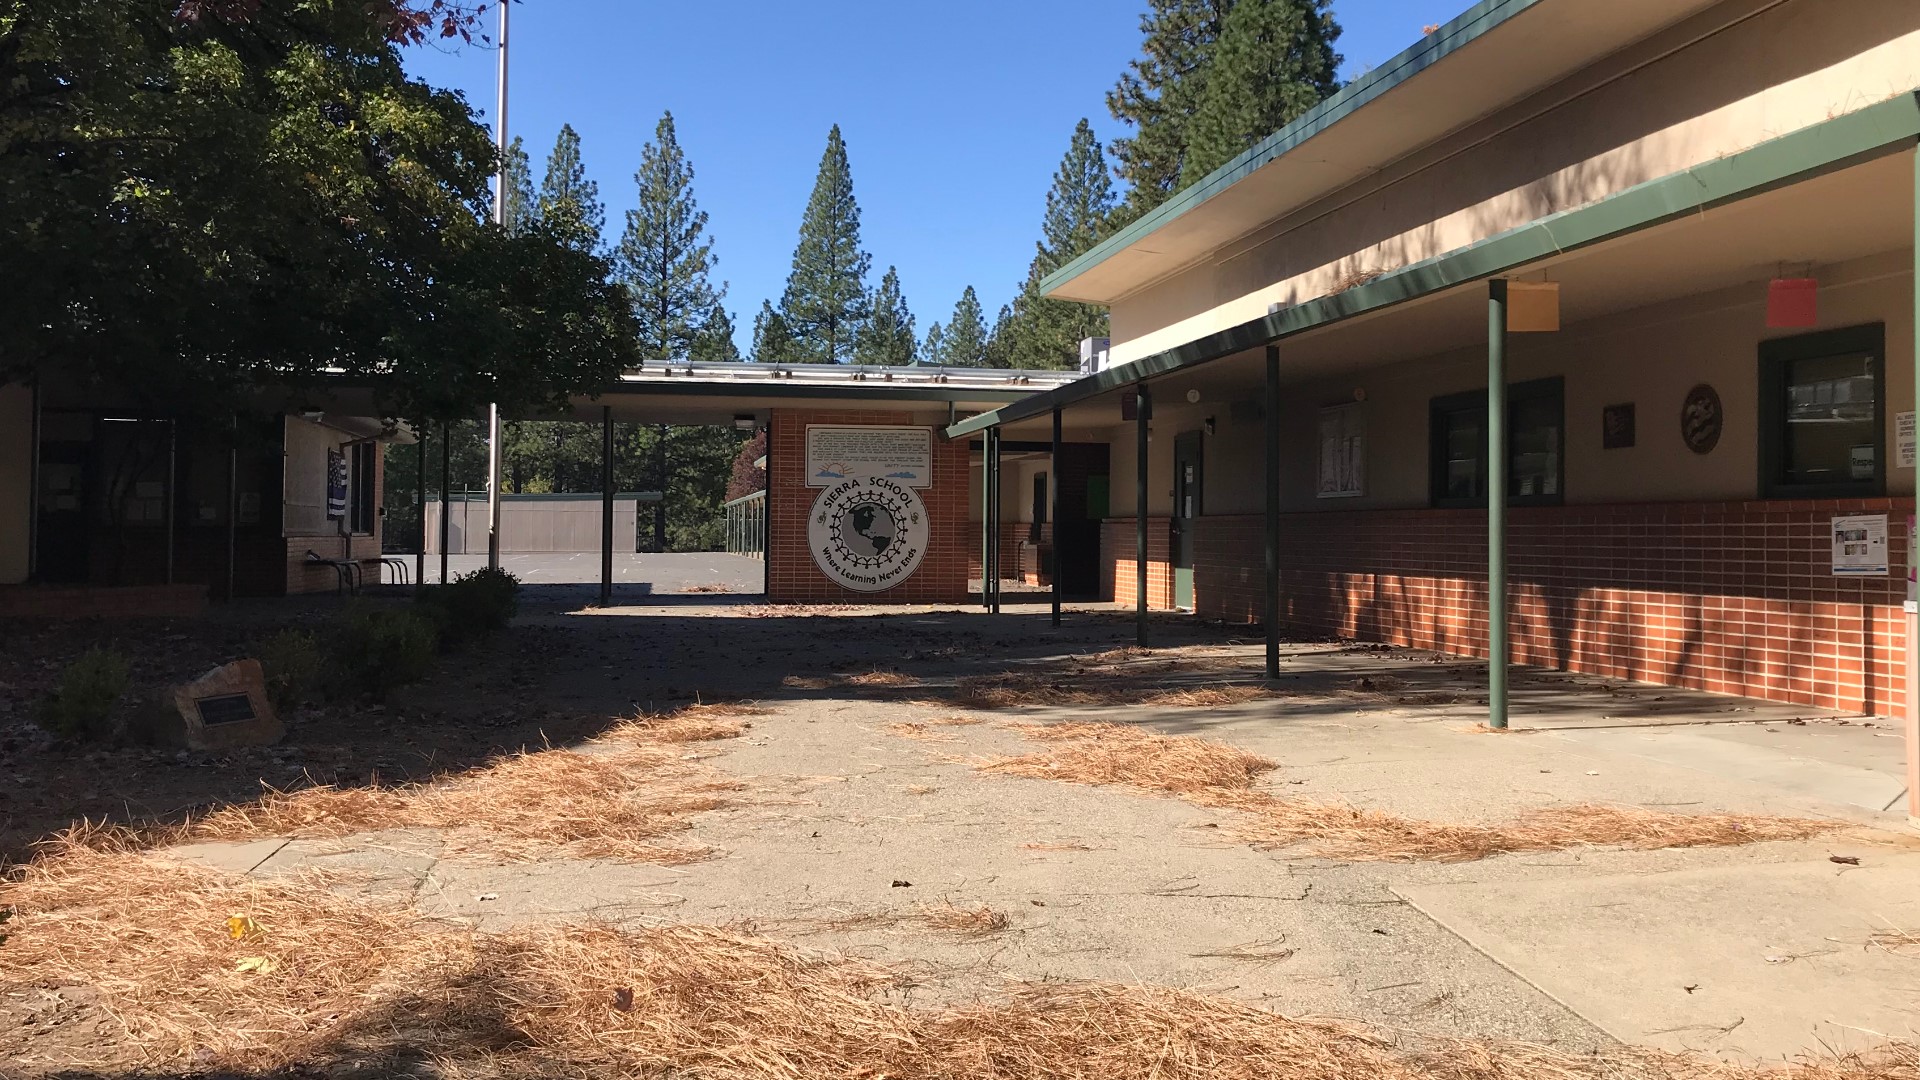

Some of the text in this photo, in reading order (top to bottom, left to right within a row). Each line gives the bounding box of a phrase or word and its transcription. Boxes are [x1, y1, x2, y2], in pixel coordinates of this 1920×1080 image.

[823, 476, 913, 509] SIERRA SCHOOL
[822, 546, 917, 585] Where Learning Never Ends
